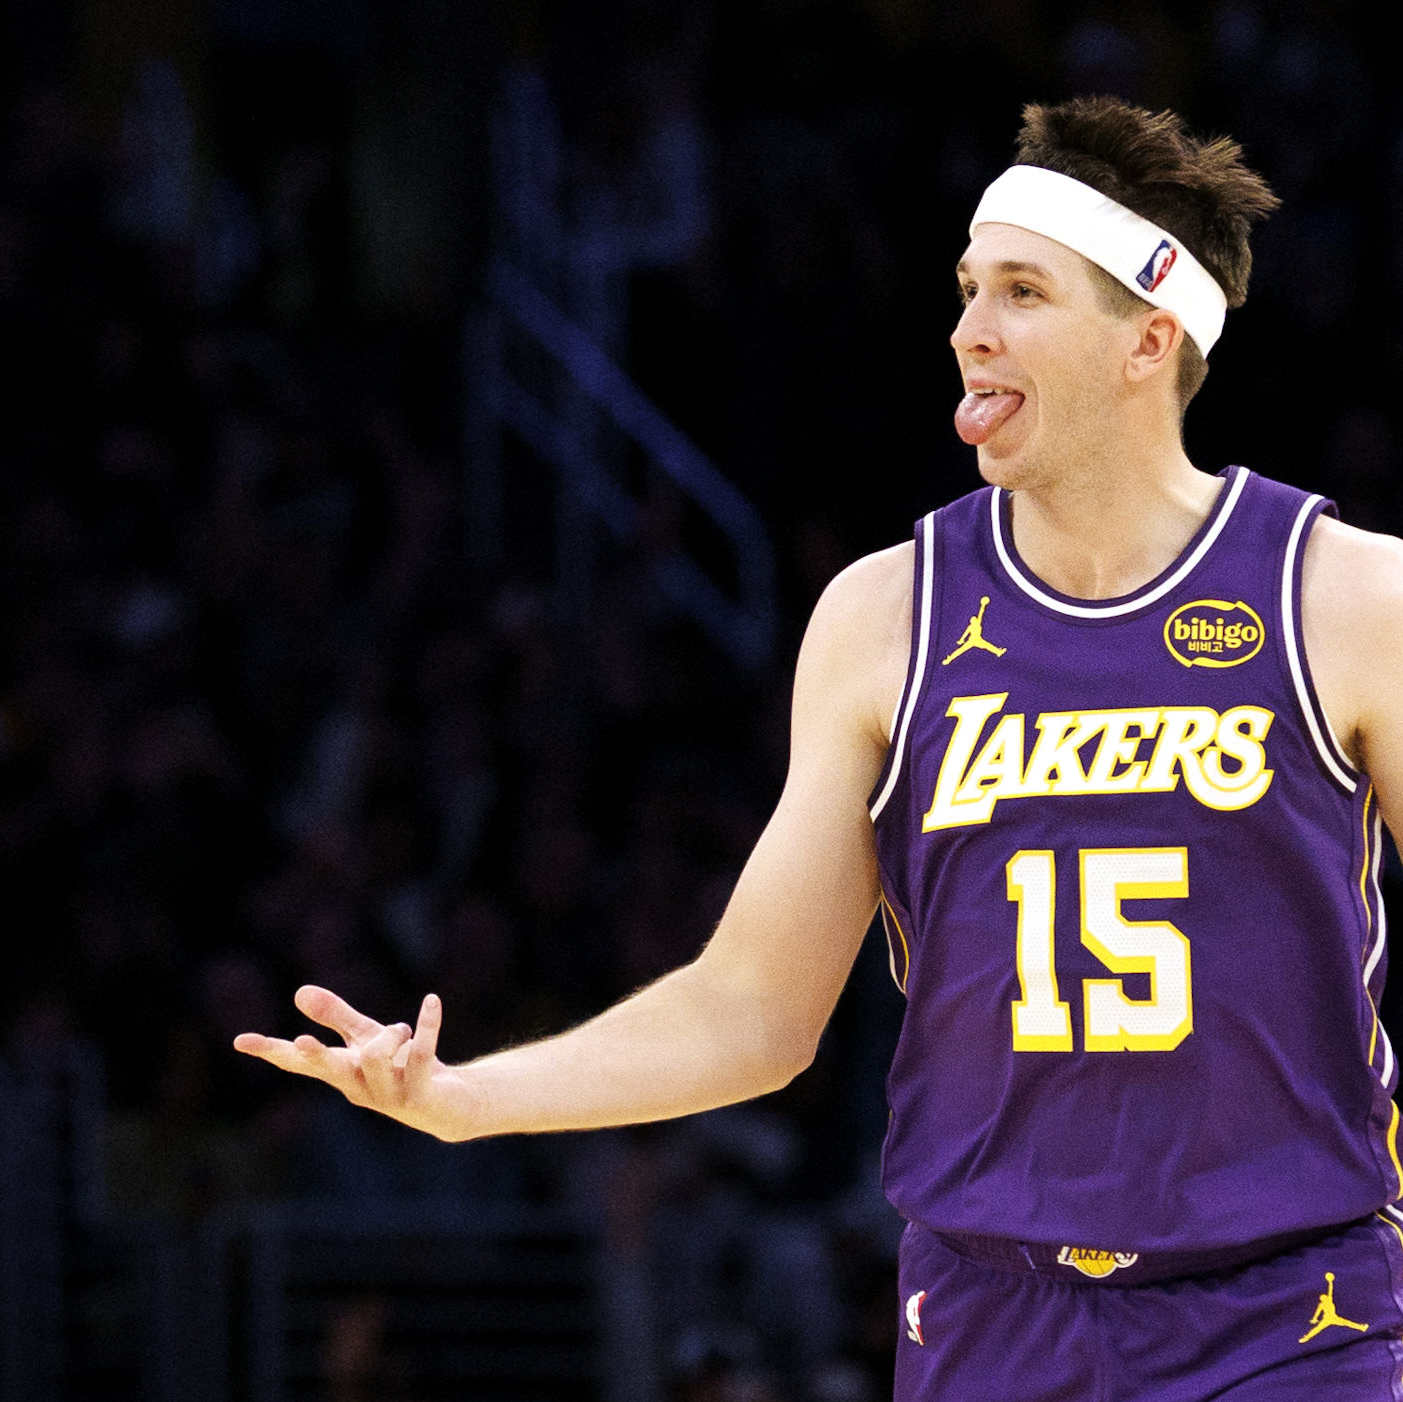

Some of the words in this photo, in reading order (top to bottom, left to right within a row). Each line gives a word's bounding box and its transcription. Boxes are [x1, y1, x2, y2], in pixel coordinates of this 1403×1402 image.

[1174, 617, 1258, 649] bibigo
[1187, 641, 1224, 653] 비비고
[922, 692, 1274, 833] LAKERS
[1005, 846, 1194, 1053] 15
